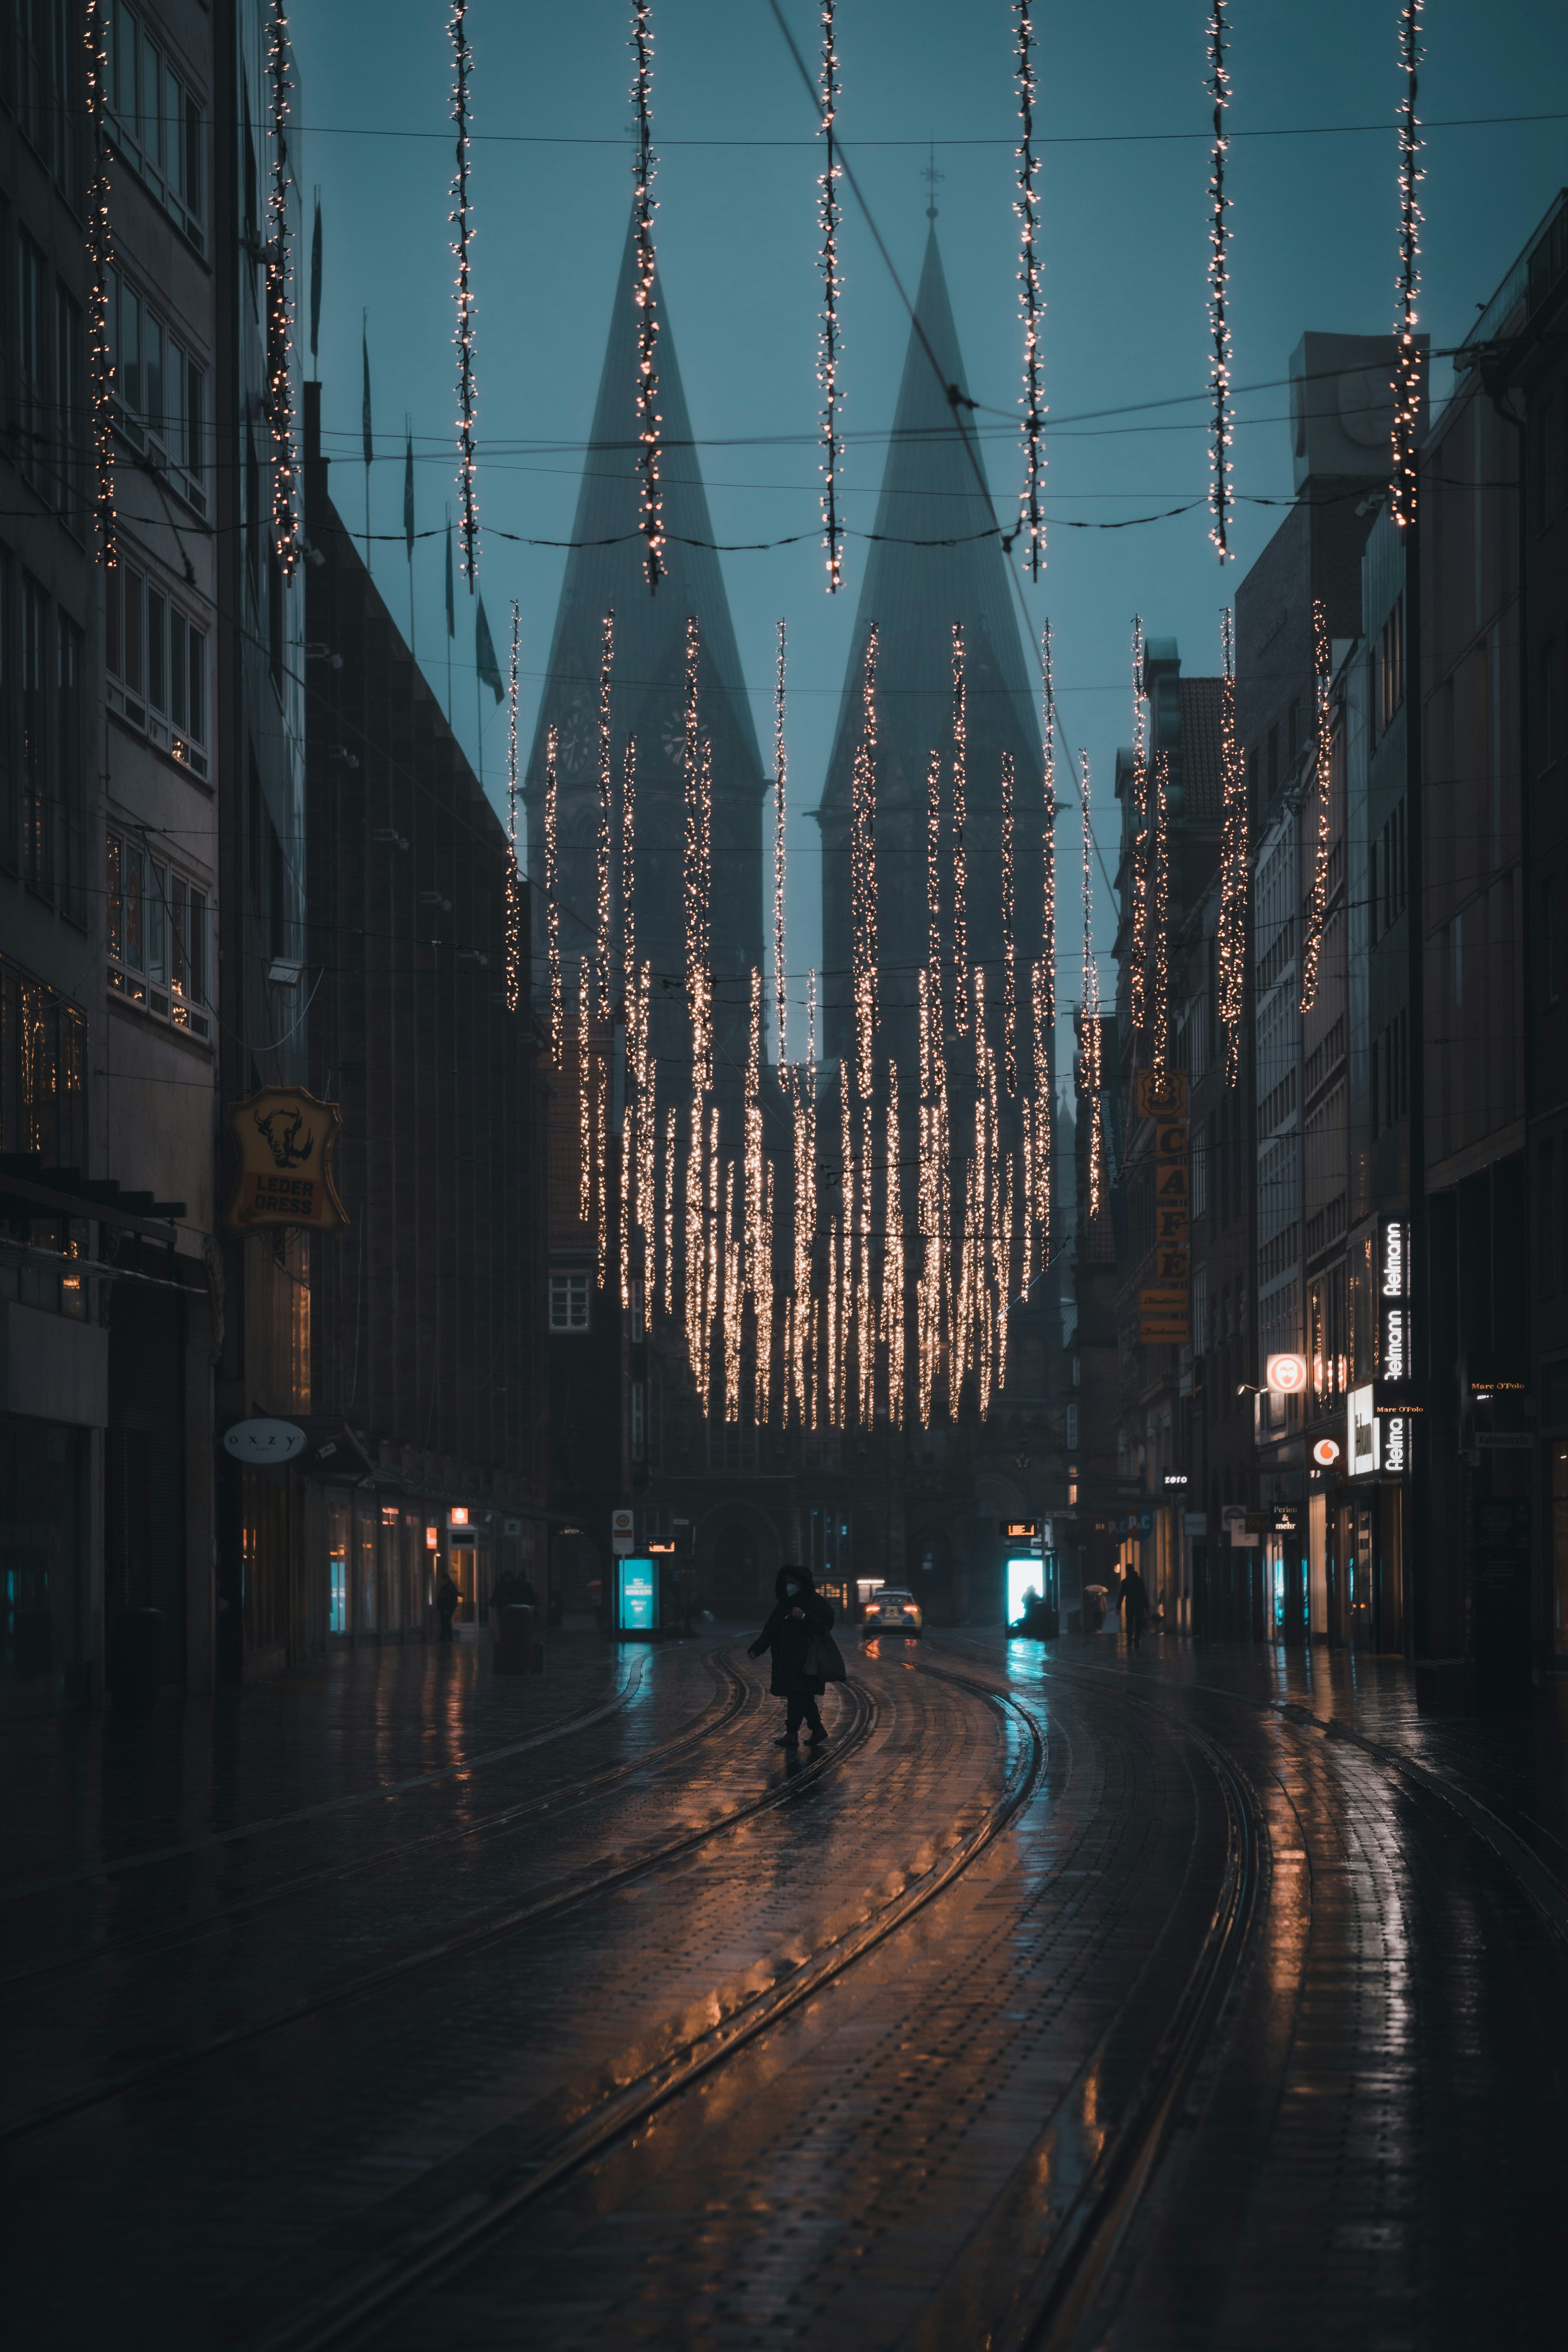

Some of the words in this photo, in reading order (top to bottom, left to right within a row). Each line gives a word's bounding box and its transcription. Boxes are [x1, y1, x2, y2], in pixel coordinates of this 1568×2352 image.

[257, 1176, 314, 1197] LEDER
[255, 1194, 312, 1215] DRESS
[1159, 1128, 1187, 1278] CAFÉ
[1383, 1223, 1401, 1295] fielmann
[1479, 1435, 1529, 1445] Kahlenstraße
